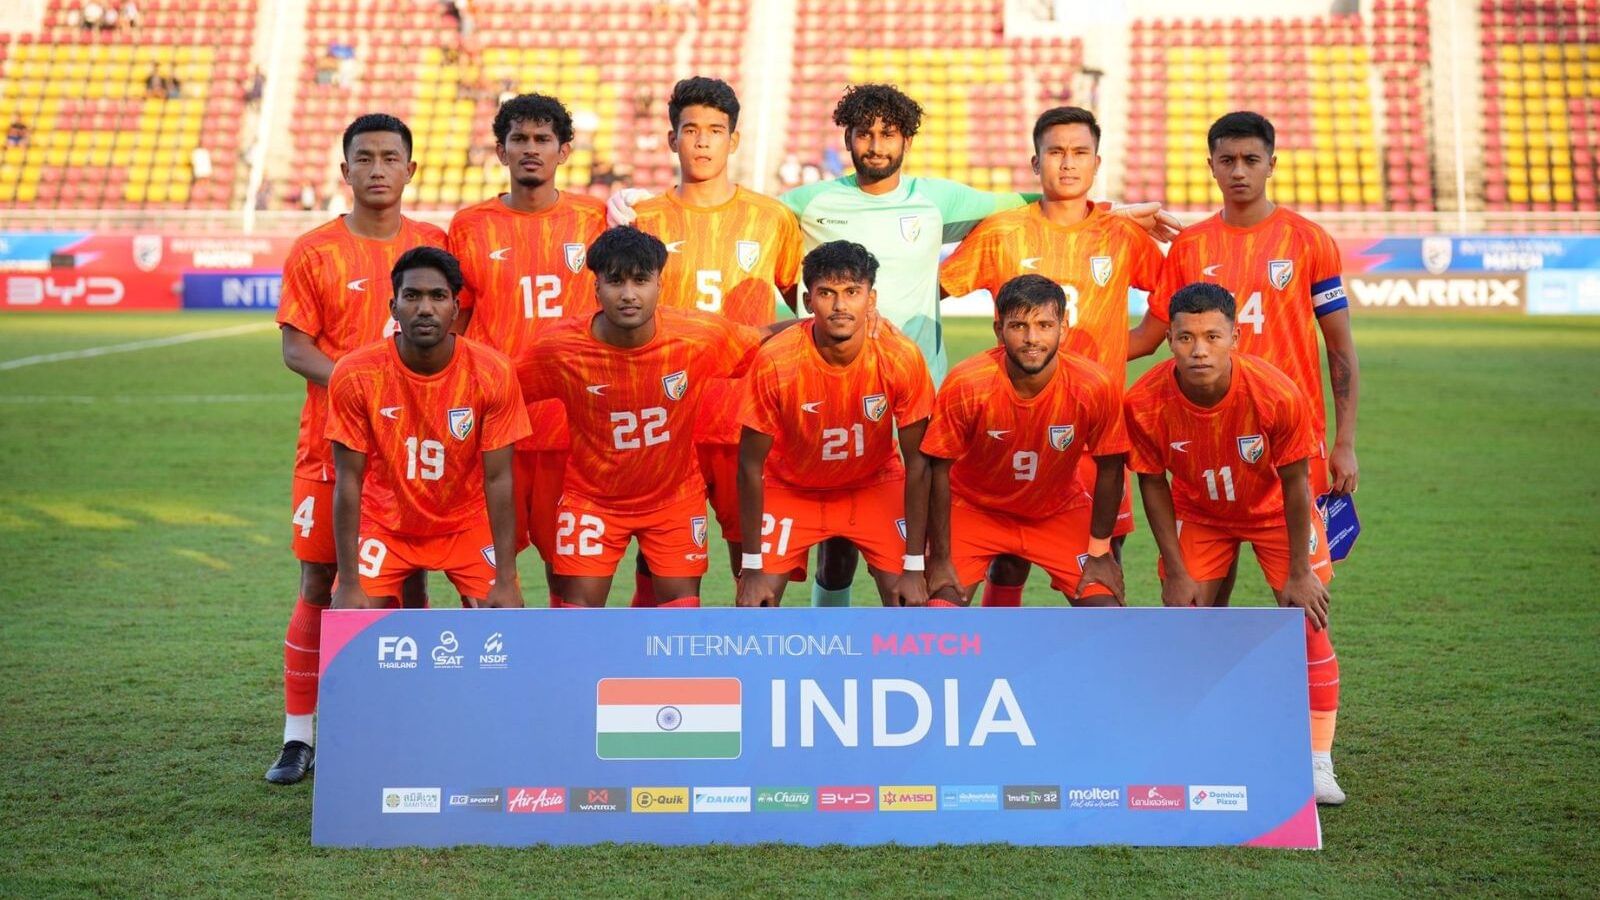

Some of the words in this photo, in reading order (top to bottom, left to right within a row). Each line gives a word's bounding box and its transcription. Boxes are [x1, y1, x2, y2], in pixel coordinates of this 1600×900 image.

[7, 276, 125, 305] BYD
[519, 274, 563, 319] 12
[696, 270, 723, 312] 5
[1350, 279, 1520, 307] WARRIX
[610, 406, 670, 450] 22
[822, 423, 864, 461] 21
[404, 437, 446, 480] 19
[1012, 450, 1038, 482] 9
[1201, 466, 1236, 502] 11
[292, 495, 316, 538] 4
[556, 511, 606, 556] 22
[761, 513, 794, 556] 21
[378, 636, 418, 661] FA
[434, 655, 464, 665] SAT
[479, 655, 508, 663] NSDF
[646, 634, 862, 657] INTERNATIONAL
[871, 633, 982, 656] MATCH
[770, 678, 1037, 748] INDIA
[706, 795, 748, 803] DAIKIN
[774, 791, 810, 805] Chang
[821, 793, 871, 804] BYD
[1043, 793, 1057, 802] 32
[1069, 787, 1119, 800] molten
